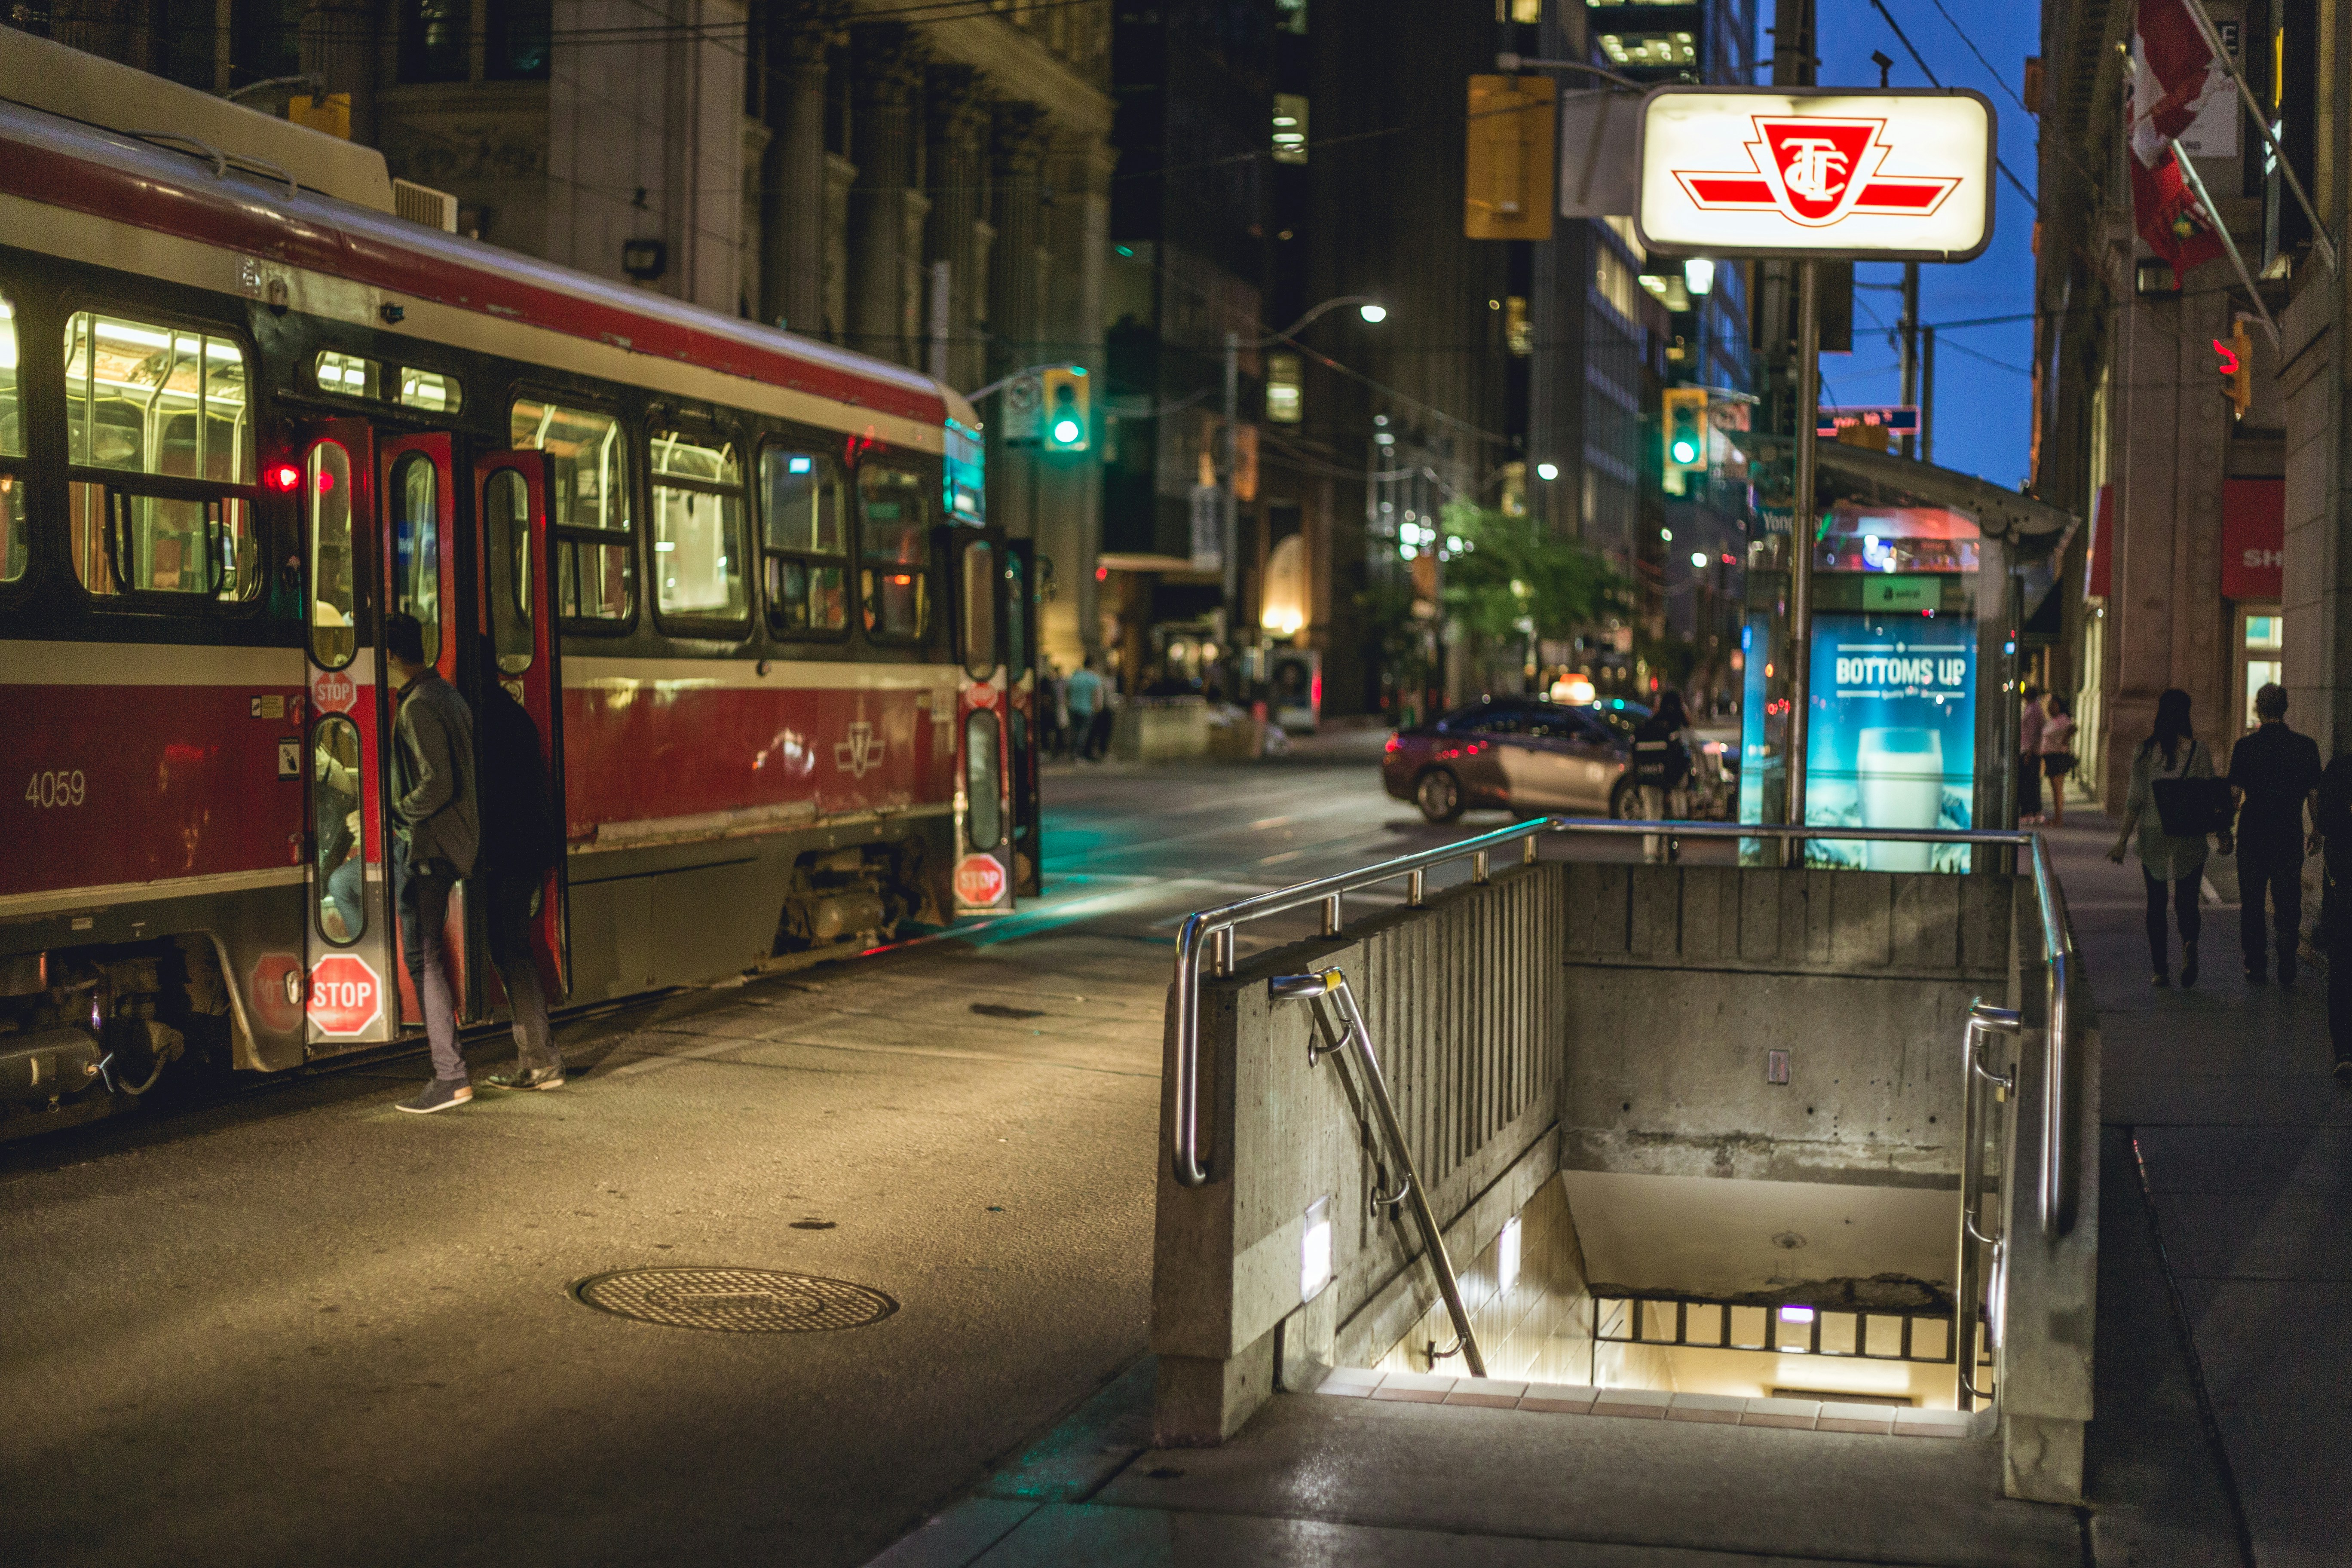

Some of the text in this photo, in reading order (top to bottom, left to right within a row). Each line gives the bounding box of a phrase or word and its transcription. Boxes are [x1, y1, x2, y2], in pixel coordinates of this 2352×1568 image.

[1780, 138, 1849, 202] TTC
[1836, 657, 1966, 686] BOTTOMS UP
[317, 683, 350, 701] STOP
[24, 770, 85, 808] 4059
[961, 870, 1000, 889] STOP
[313, 982, 371, 1008] STOP
